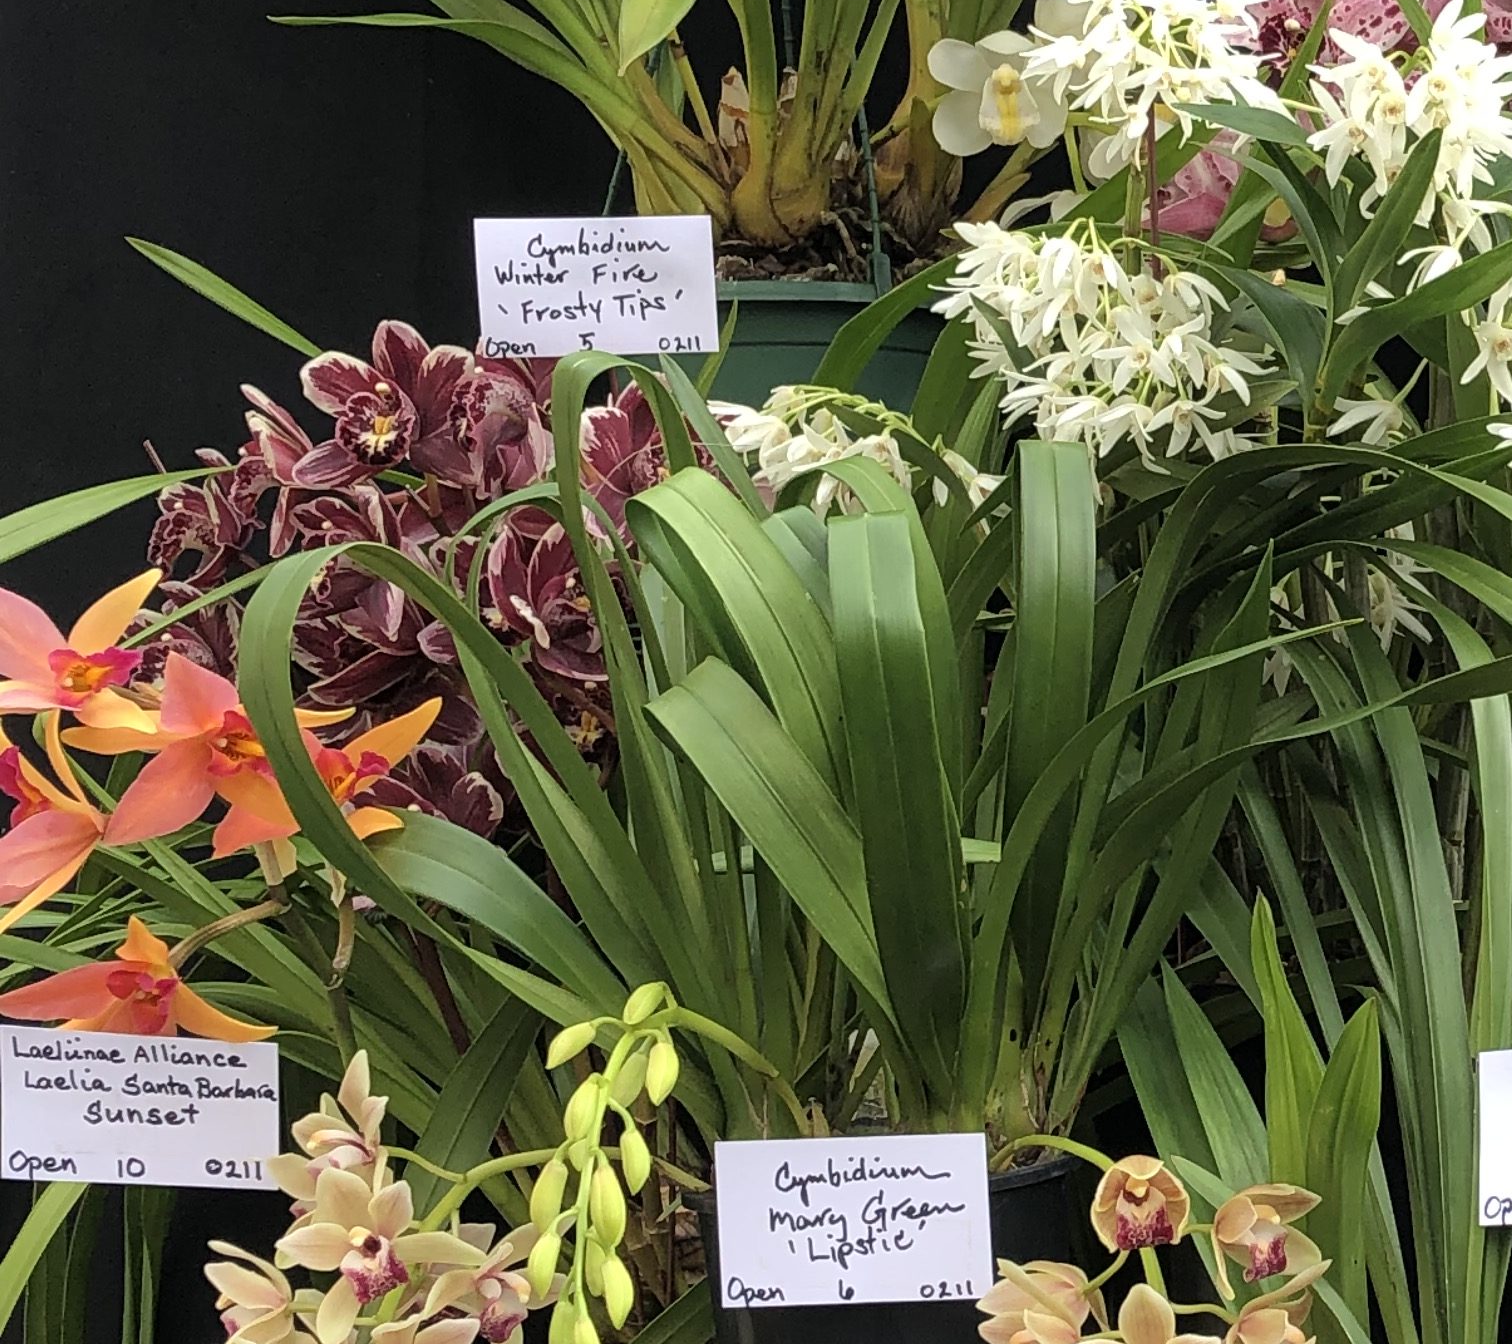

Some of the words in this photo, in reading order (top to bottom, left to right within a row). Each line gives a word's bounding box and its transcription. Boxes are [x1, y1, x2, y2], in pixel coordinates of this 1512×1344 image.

[527, 227, 670, 267] Cymbidium
[494, 260, 569, 286] Winter
[592, 258, 658, 285] Fire
[486, 337, 536, 357] Open
[579, 332, 595, 350] 5
[658, 336, 701, 352] 0211
[133, 1044, 247, 1069] Alliance
[24, 1068, 112, 1091] Laelia
[121, 1074, 193, 1097] Santa
[195, 1077, 277, 1102] Barbara
[83, 1100, 200, 1126] Sunset
[9, 1149, 77, 1181] Open
[117, 1158, 145, 1178] 10
[205, 1159, 263, 1180] 0211
[774, 1156, 951, 1207] Cymbidium
[861, 1189, 966, 1231] Green
[727, 1277, 785, 1306] Open
[838, 1280, 855, 1300] 6
[920, 1280, 973, 1299] 0211
